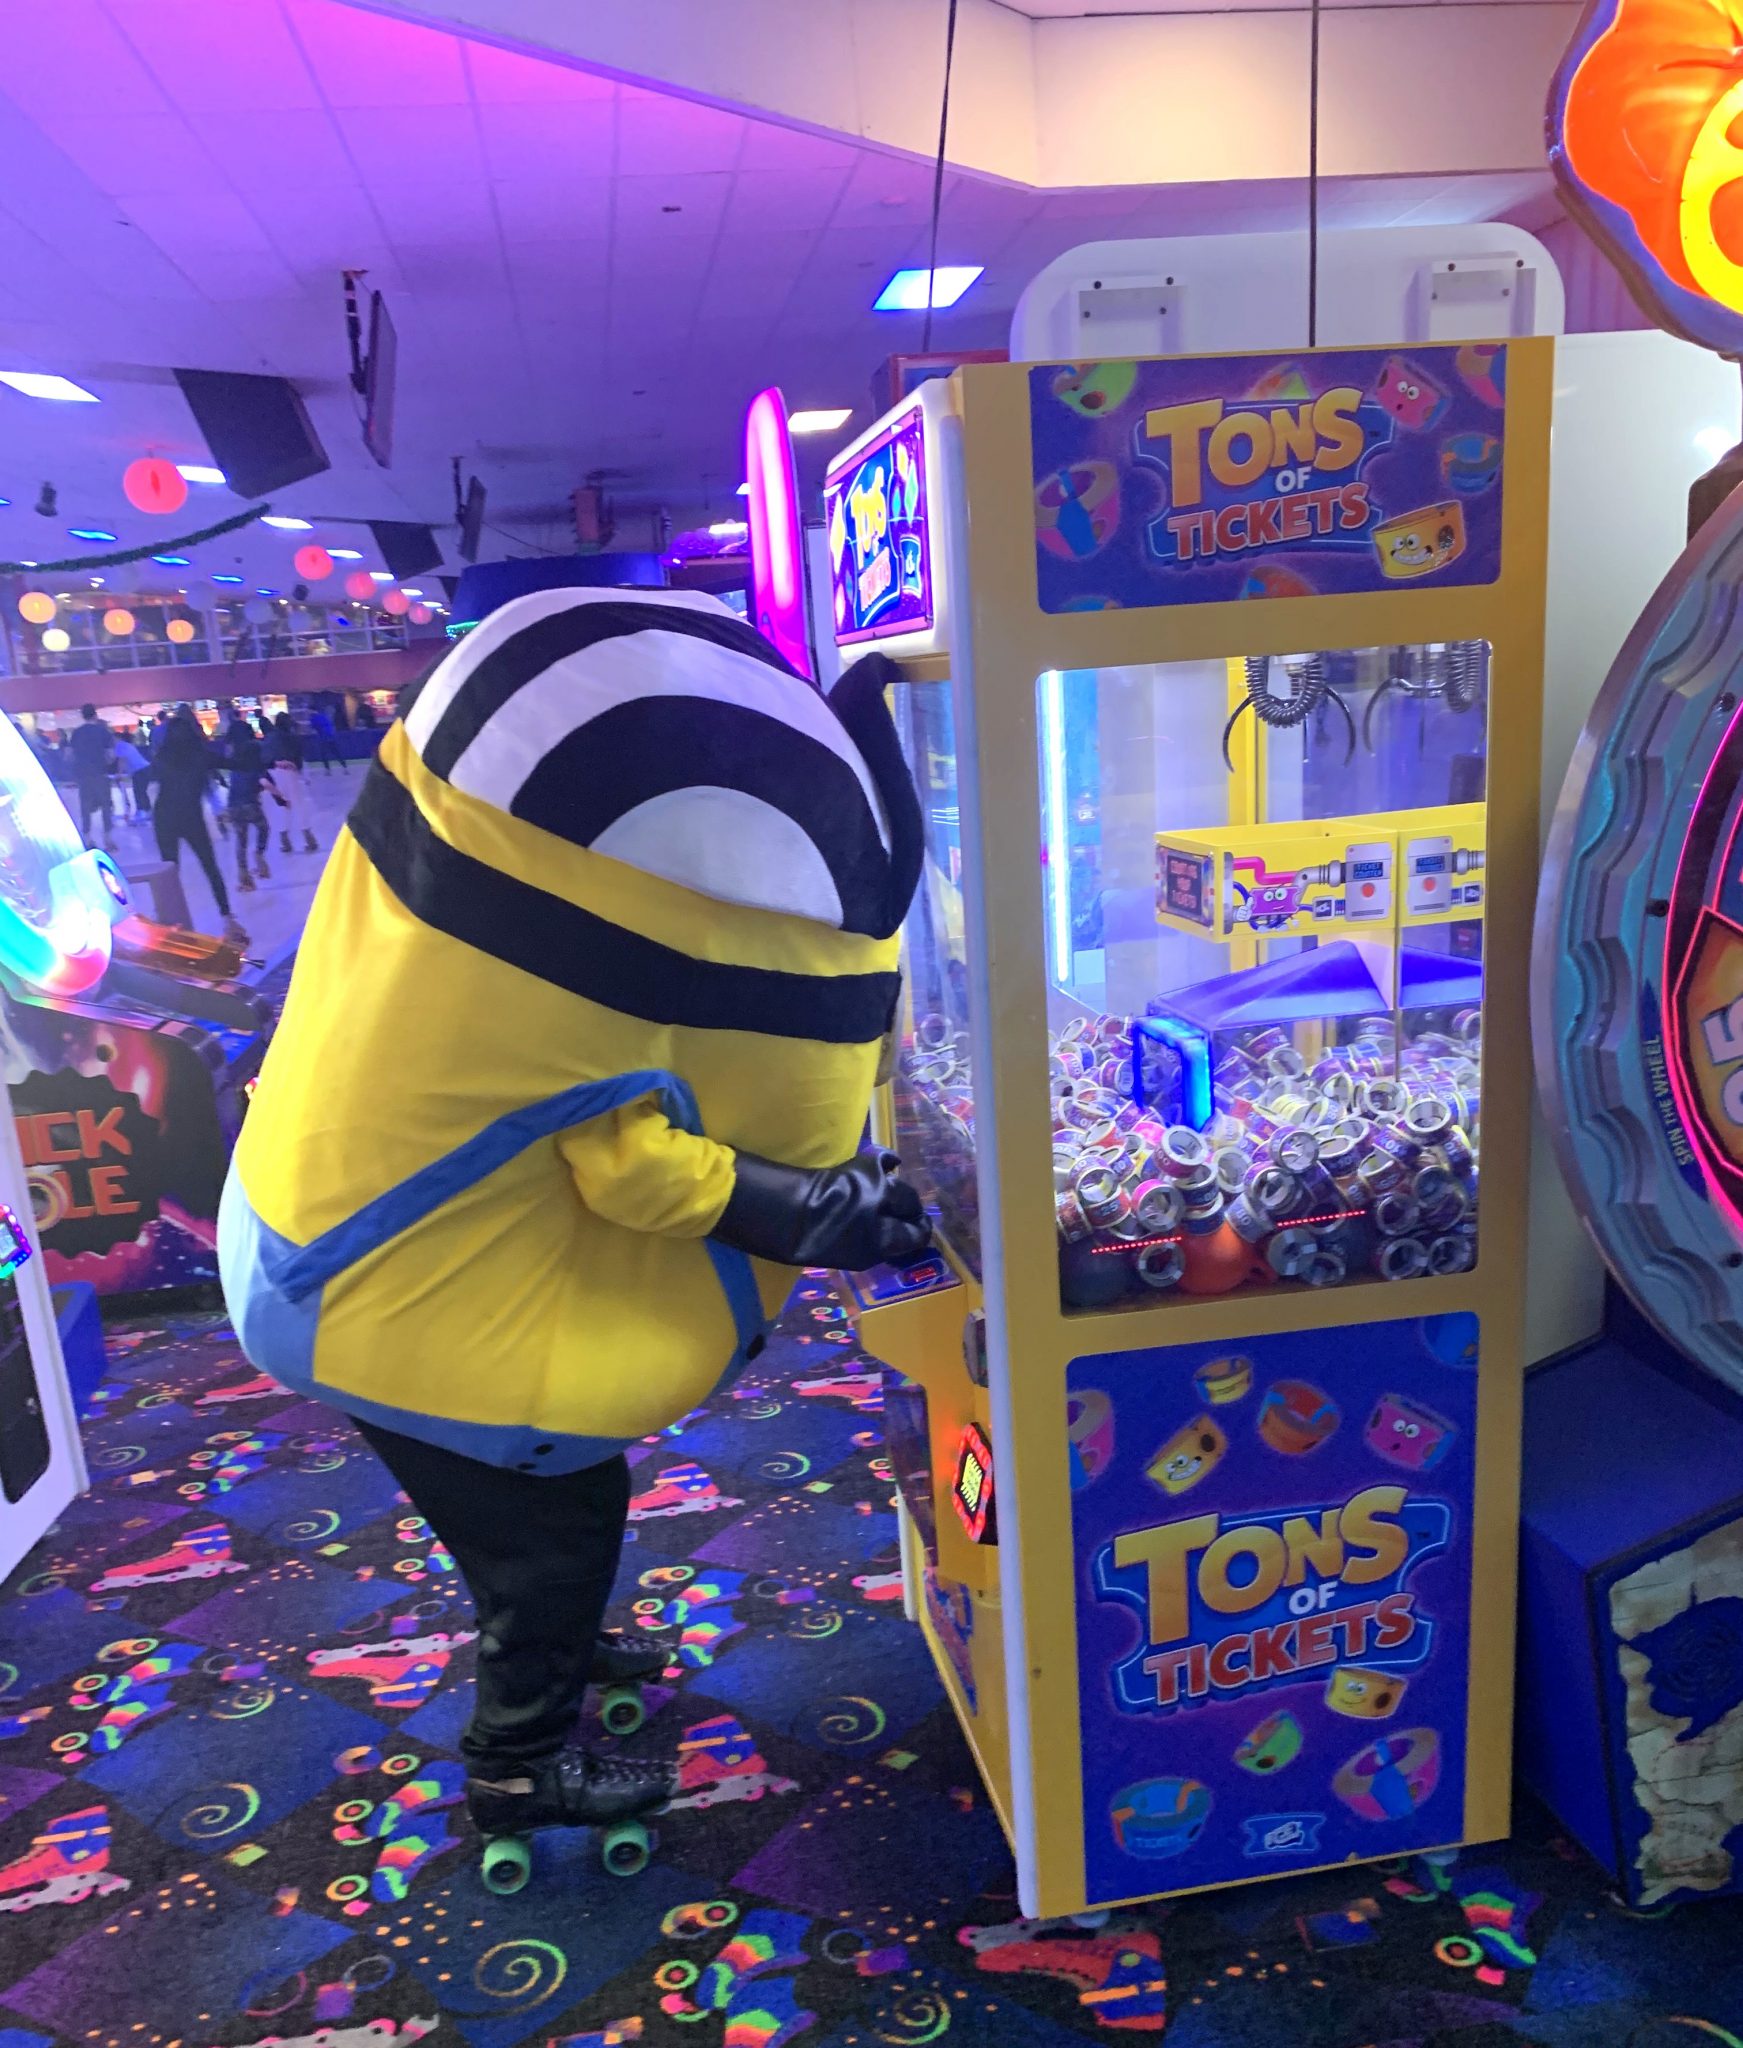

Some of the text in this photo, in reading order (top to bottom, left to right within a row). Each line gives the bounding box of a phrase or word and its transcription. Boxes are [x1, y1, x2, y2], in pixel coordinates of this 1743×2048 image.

[1146, 387, 1364, 507] TONS
[1275, 466, 1311, 493] OF
[1167, 482, 1370, 560] TICKETS
[1643, 1035, 1694, 1166] SPIN THE WHEEL
[1114, 1486, 1408, 1645] TONS
[1289, 1581, 1337, 1615] OF
[1143, 1593, 1415, 1705] TICKETS
